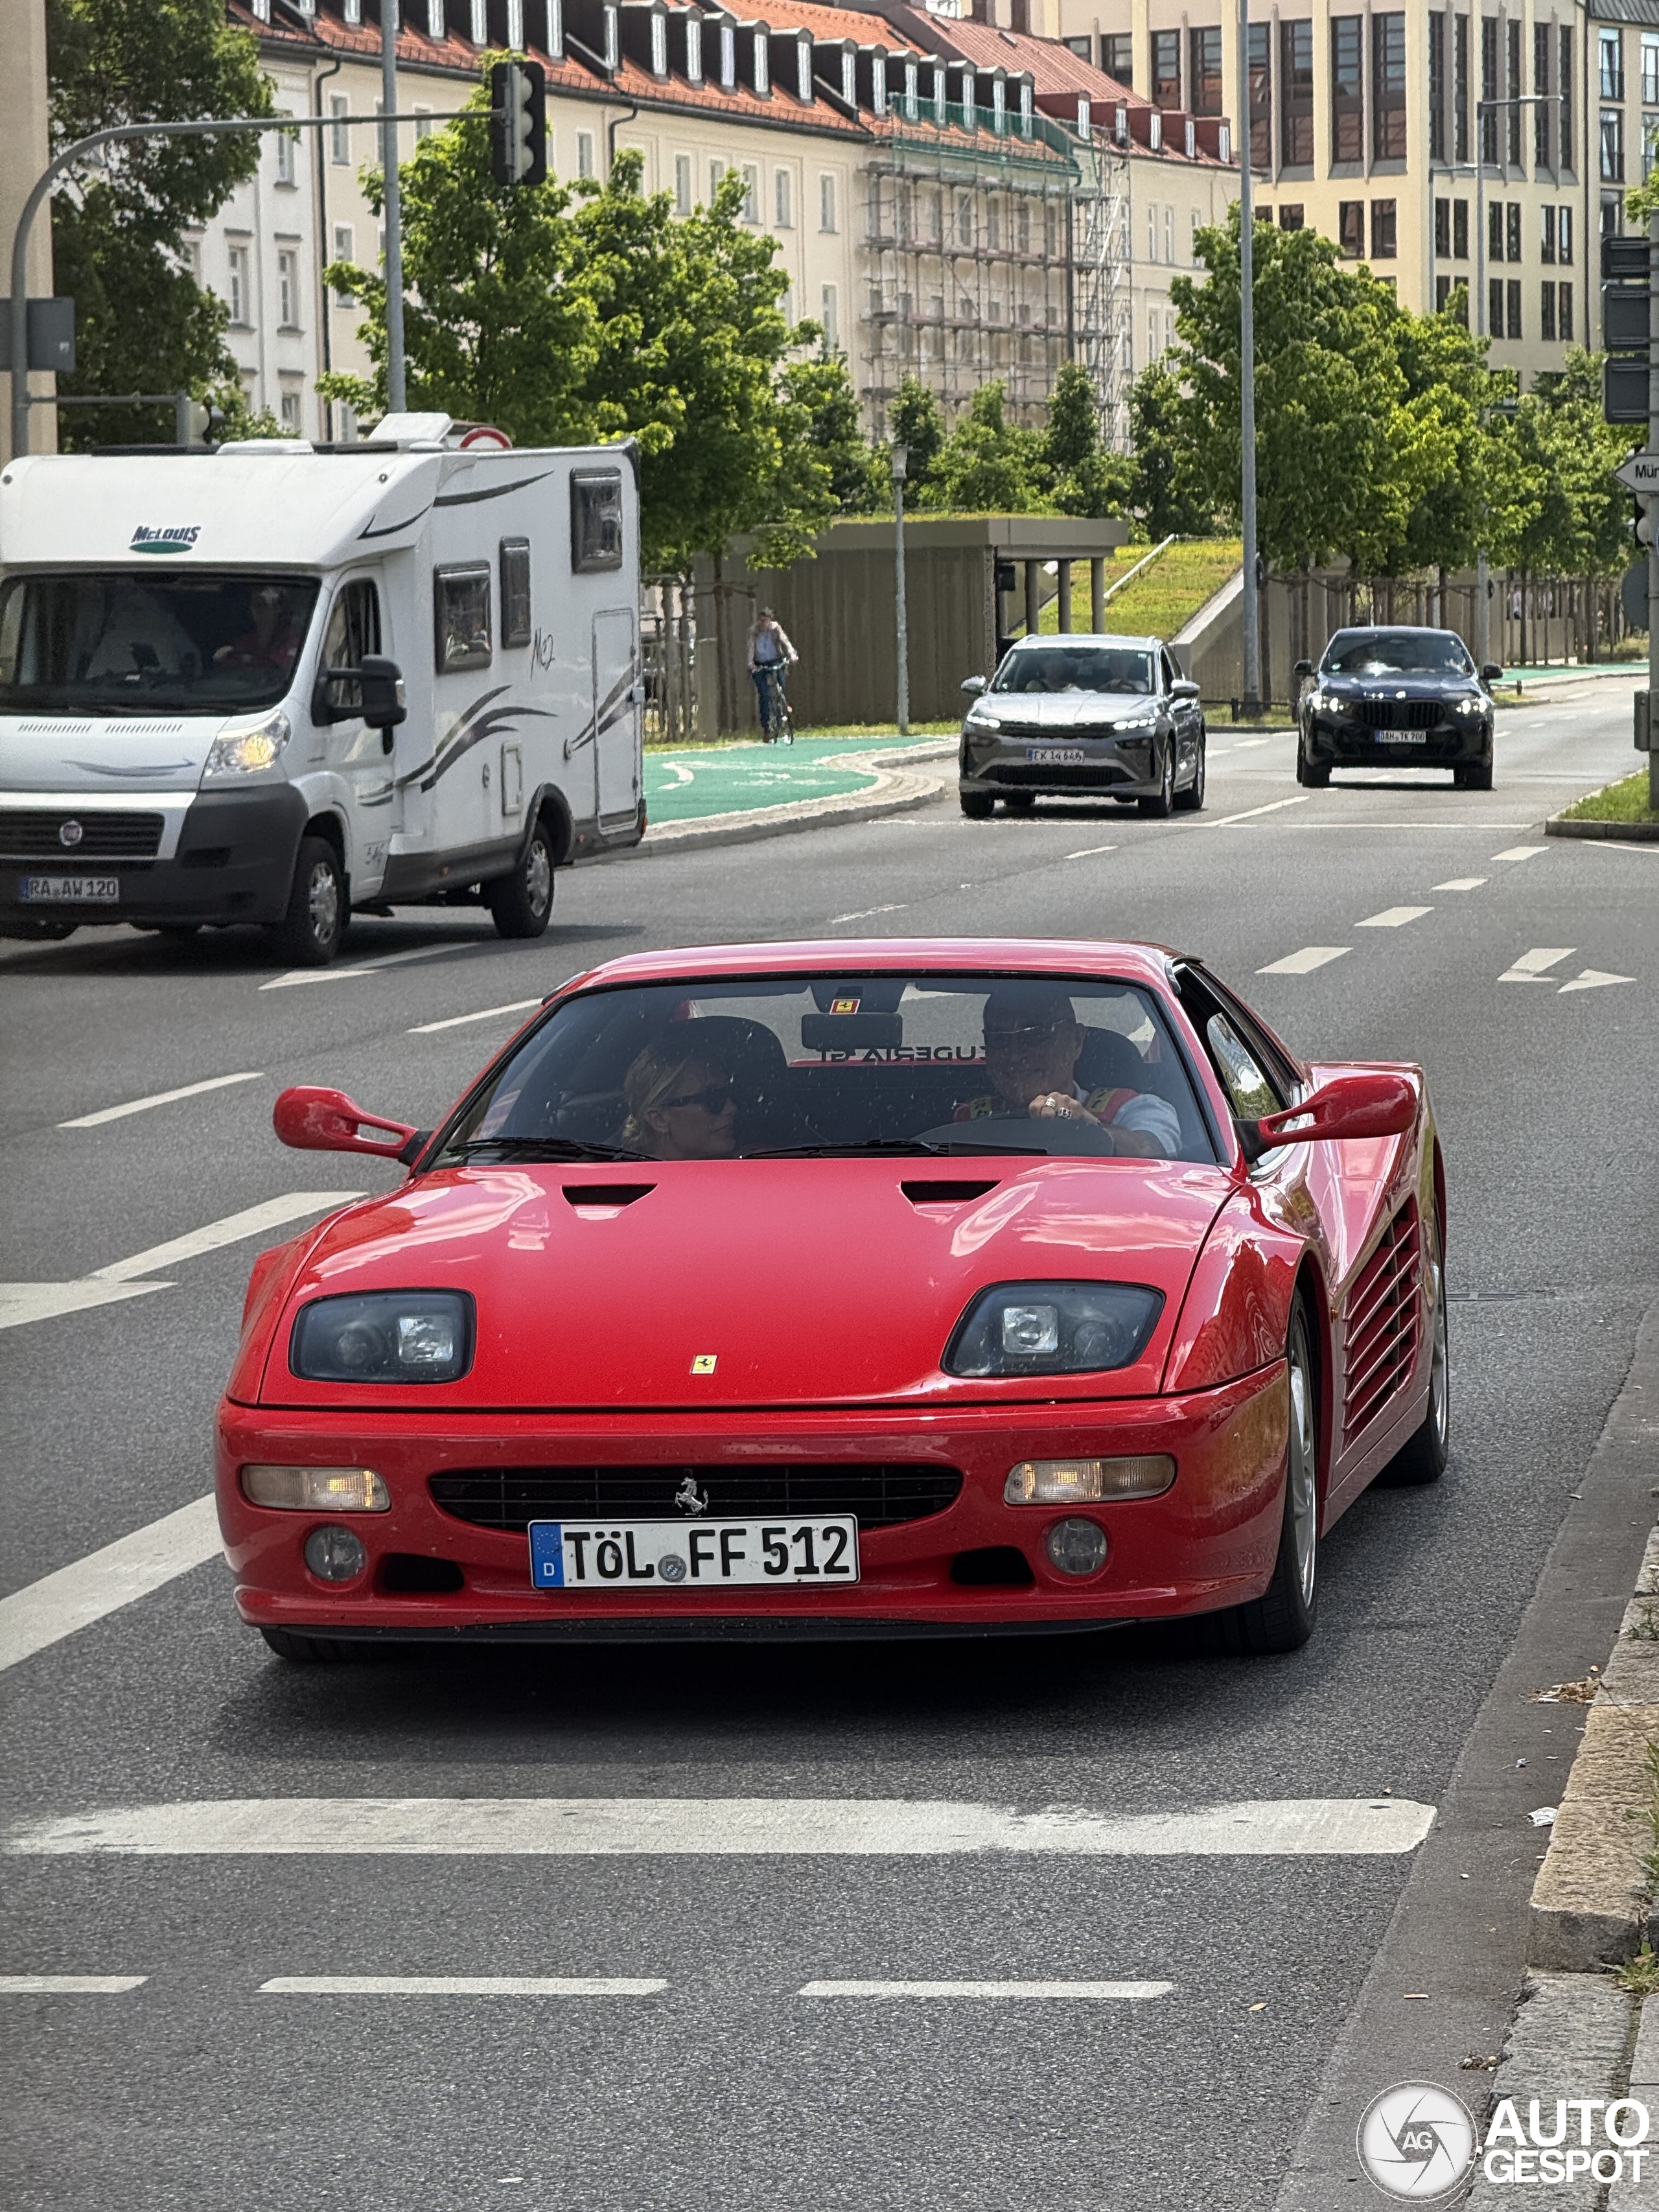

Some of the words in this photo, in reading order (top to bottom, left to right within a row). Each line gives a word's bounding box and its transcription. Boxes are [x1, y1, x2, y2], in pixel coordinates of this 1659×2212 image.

[86, 880, 116, 896] 120
[543, 1563, 555, 1577] D
[689, 1528, 747, 1578] FF
[761, 1525, 850, 1576] 512
